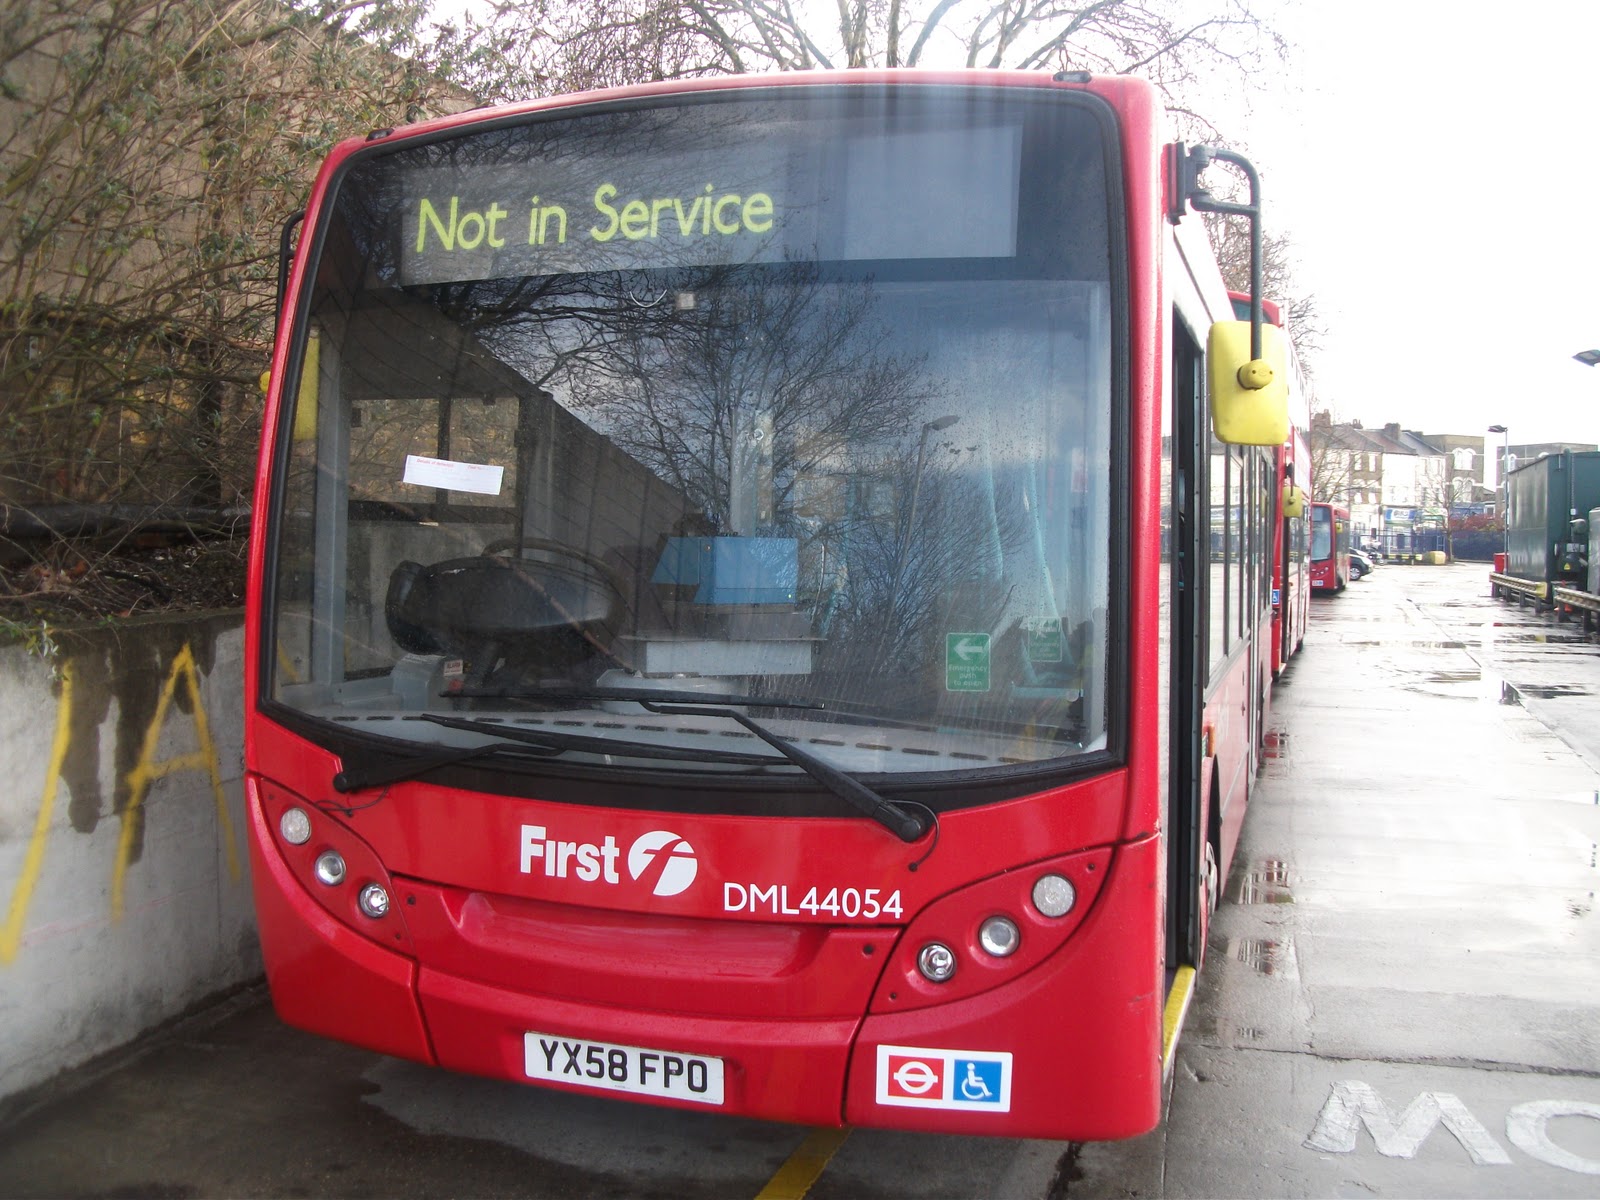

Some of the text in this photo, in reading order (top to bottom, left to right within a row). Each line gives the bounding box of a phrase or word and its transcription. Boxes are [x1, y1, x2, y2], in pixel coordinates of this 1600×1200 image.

[416, 182, 774, 253] Not in Service
[520, 823, 620, 884] First
[724, 882, 903, 919] DML44054
[539, 1039, 708, 1094] YX58 FPO
